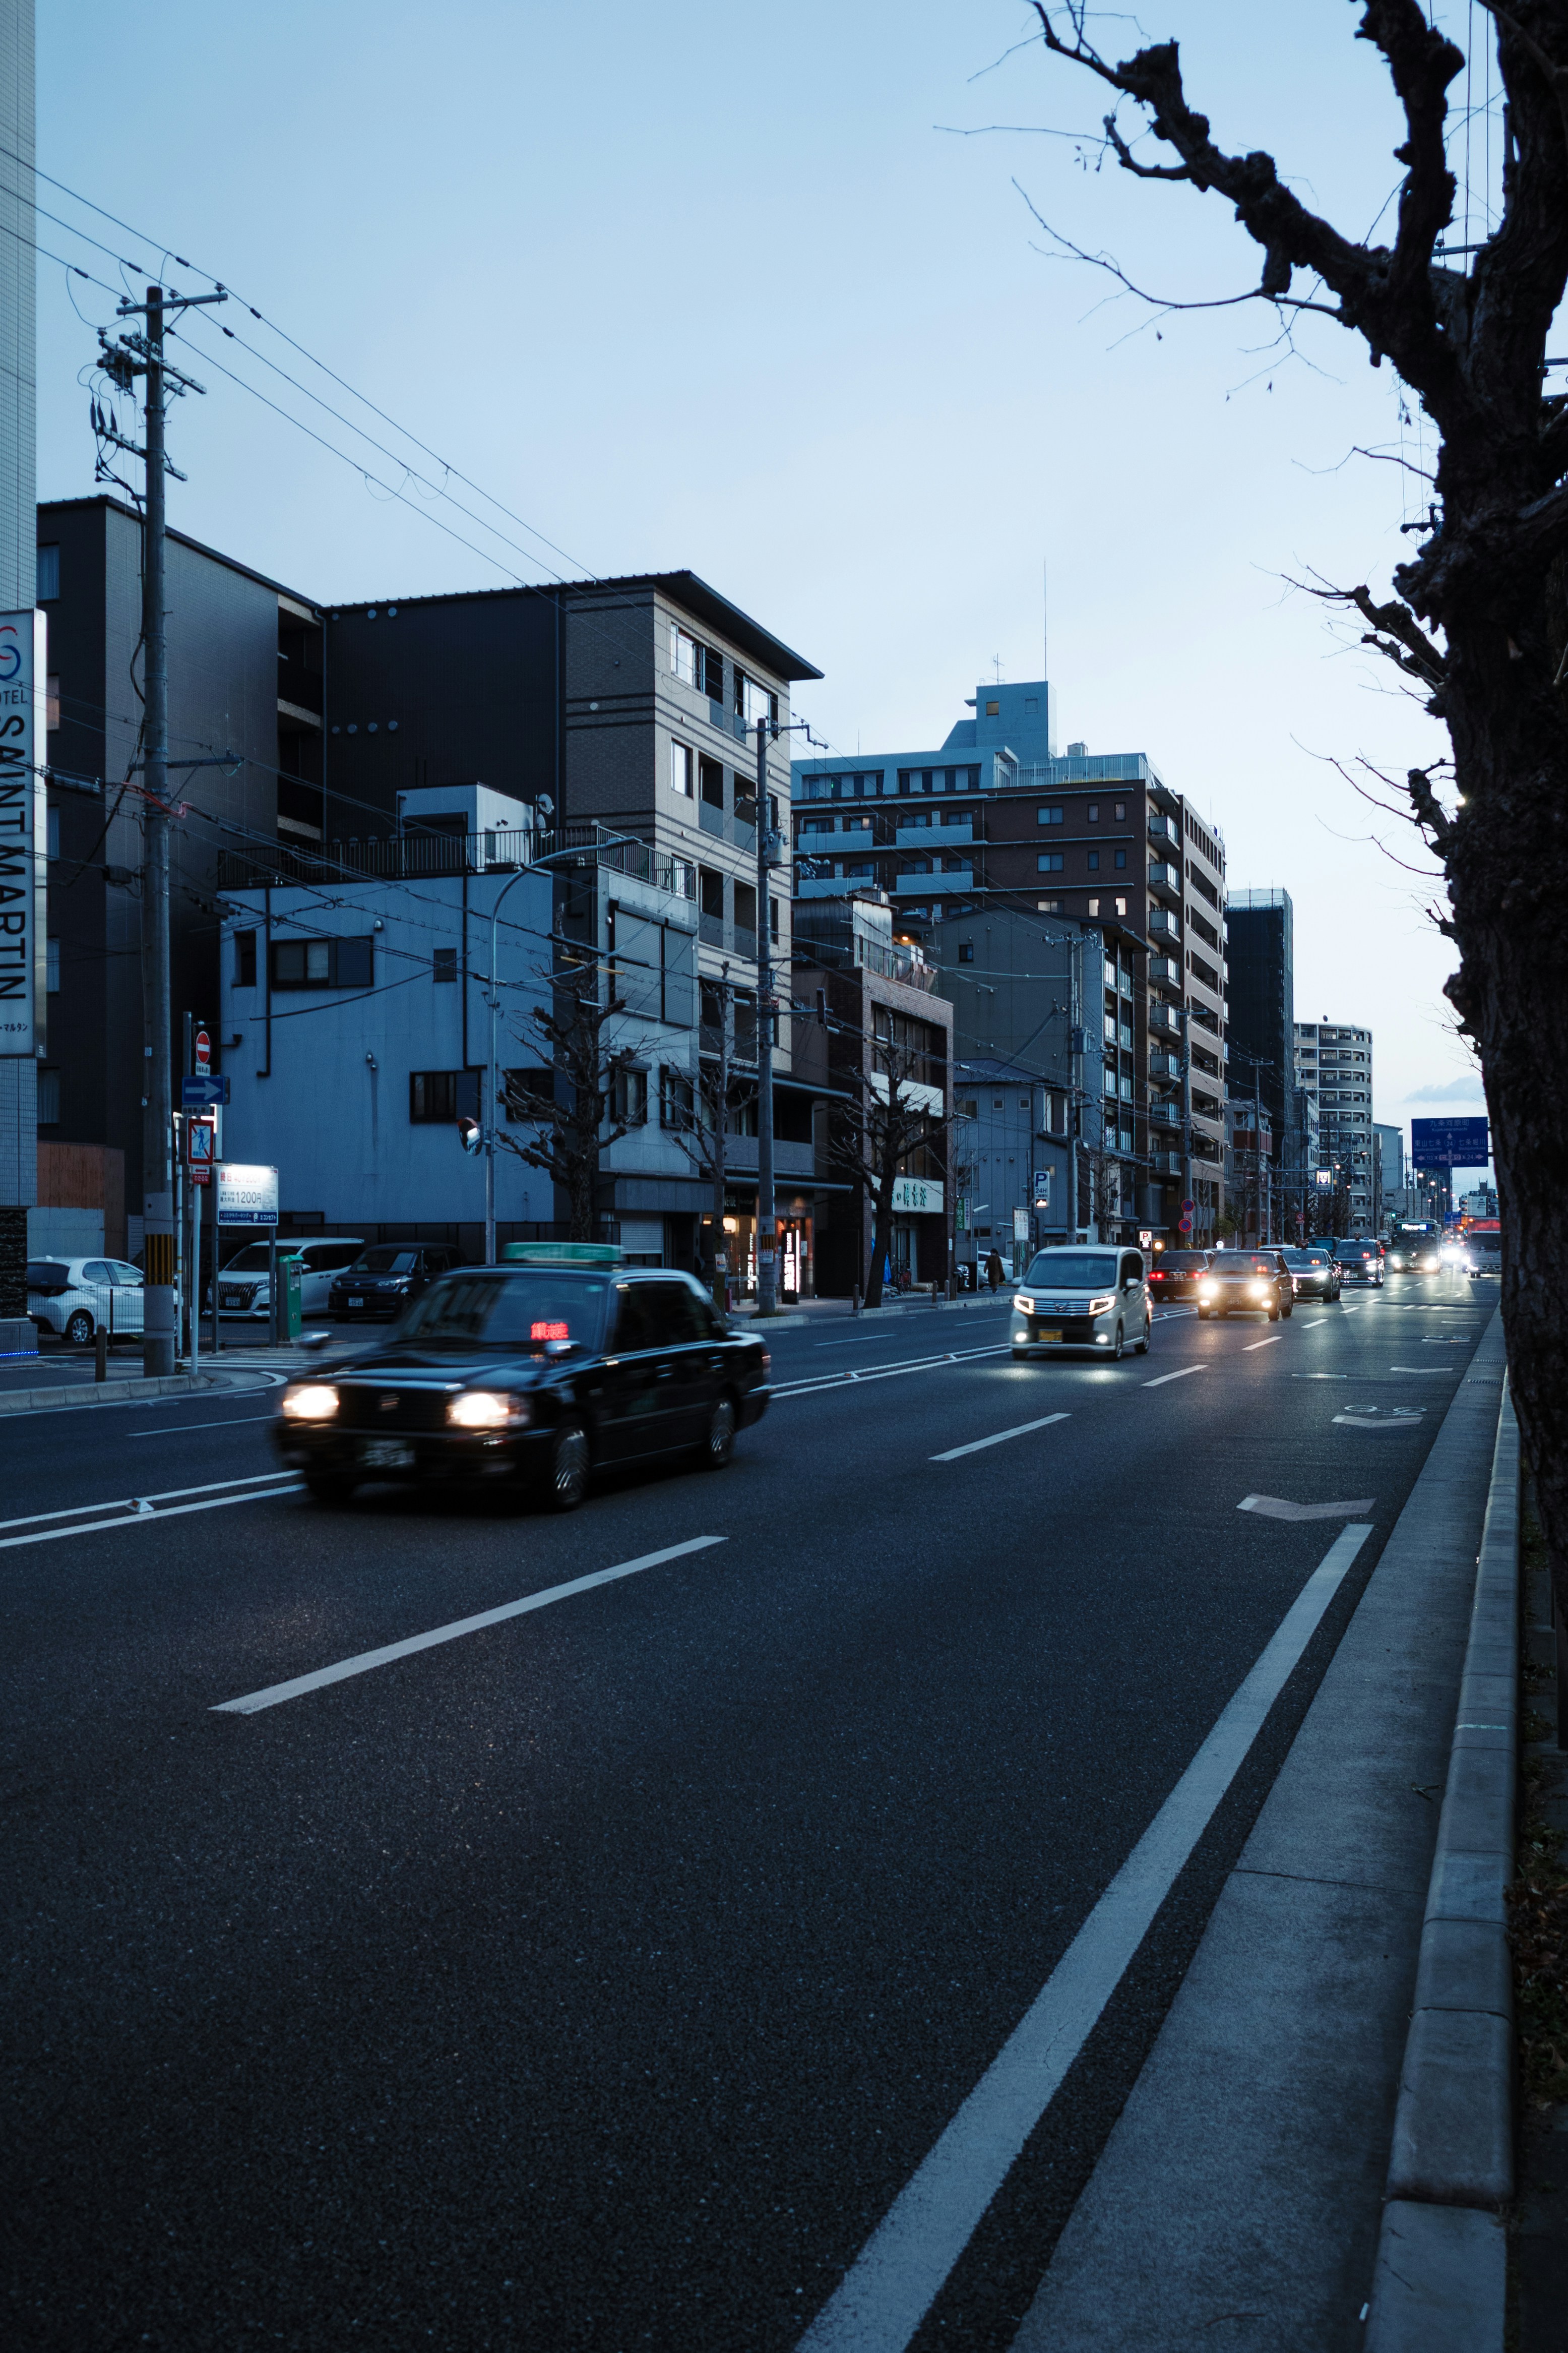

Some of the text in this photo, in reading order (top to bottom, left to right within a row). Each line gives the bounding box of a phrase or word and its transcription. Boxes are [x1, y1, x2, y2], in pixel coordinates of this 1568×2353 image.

[0, 689, 27, 704] TEL
[1429, 1119, 1470, 1127] 九条河原町
[1415, 1139, 1441, 1147] 東山七条
[220, 1171, 232, 1182] 終日
[1035, 1173, 1047, 1187] P
[236, 1191, 262, 1203] 1200円
